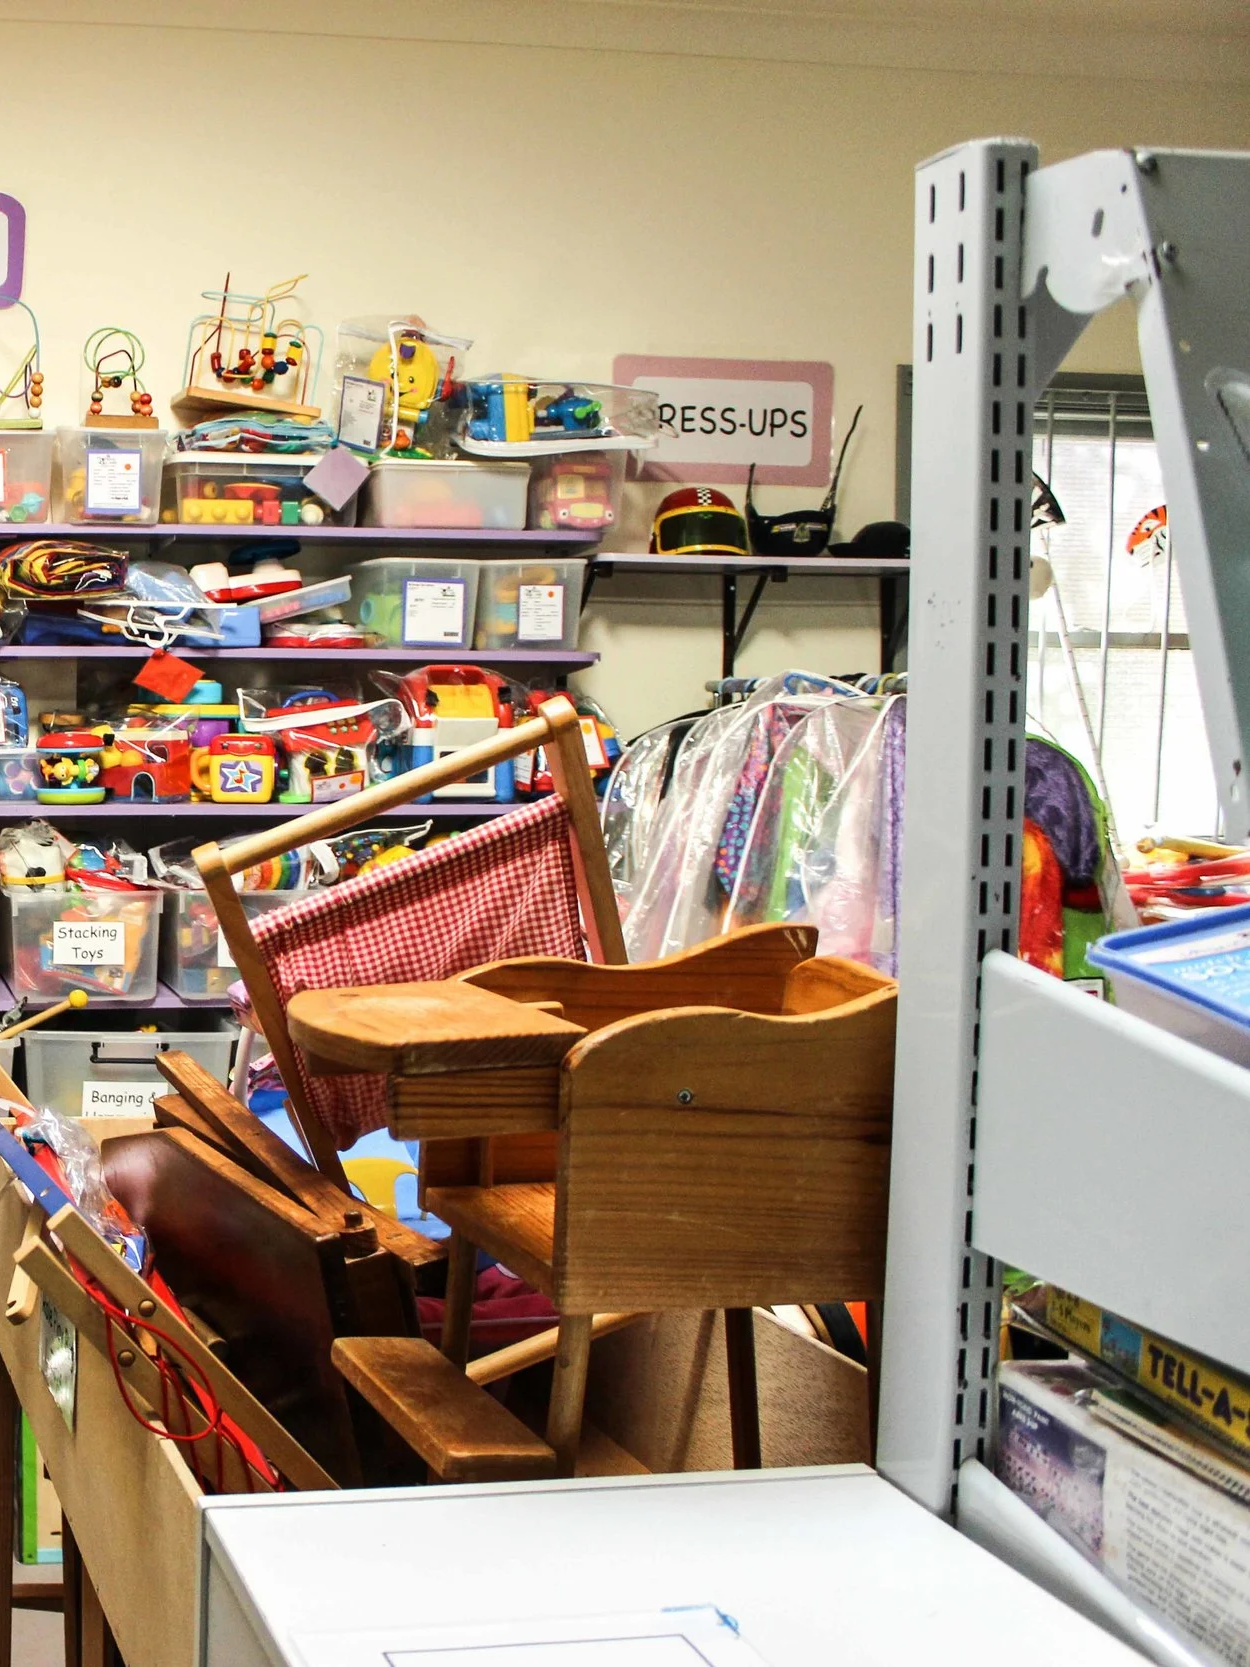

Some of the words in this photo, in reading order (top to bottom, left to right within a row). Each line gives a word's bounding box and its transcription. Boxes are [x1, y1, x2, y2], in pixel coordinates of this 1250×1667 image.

[657, 403, 808, 438] RESS-UPS
[58, 927, 117, 941] Stacking
[71, 947, 104, 959] Toys
[91, 1090, 144, 1107] Banging
[1148, 1343, 1249, 1440] TELL-A-
